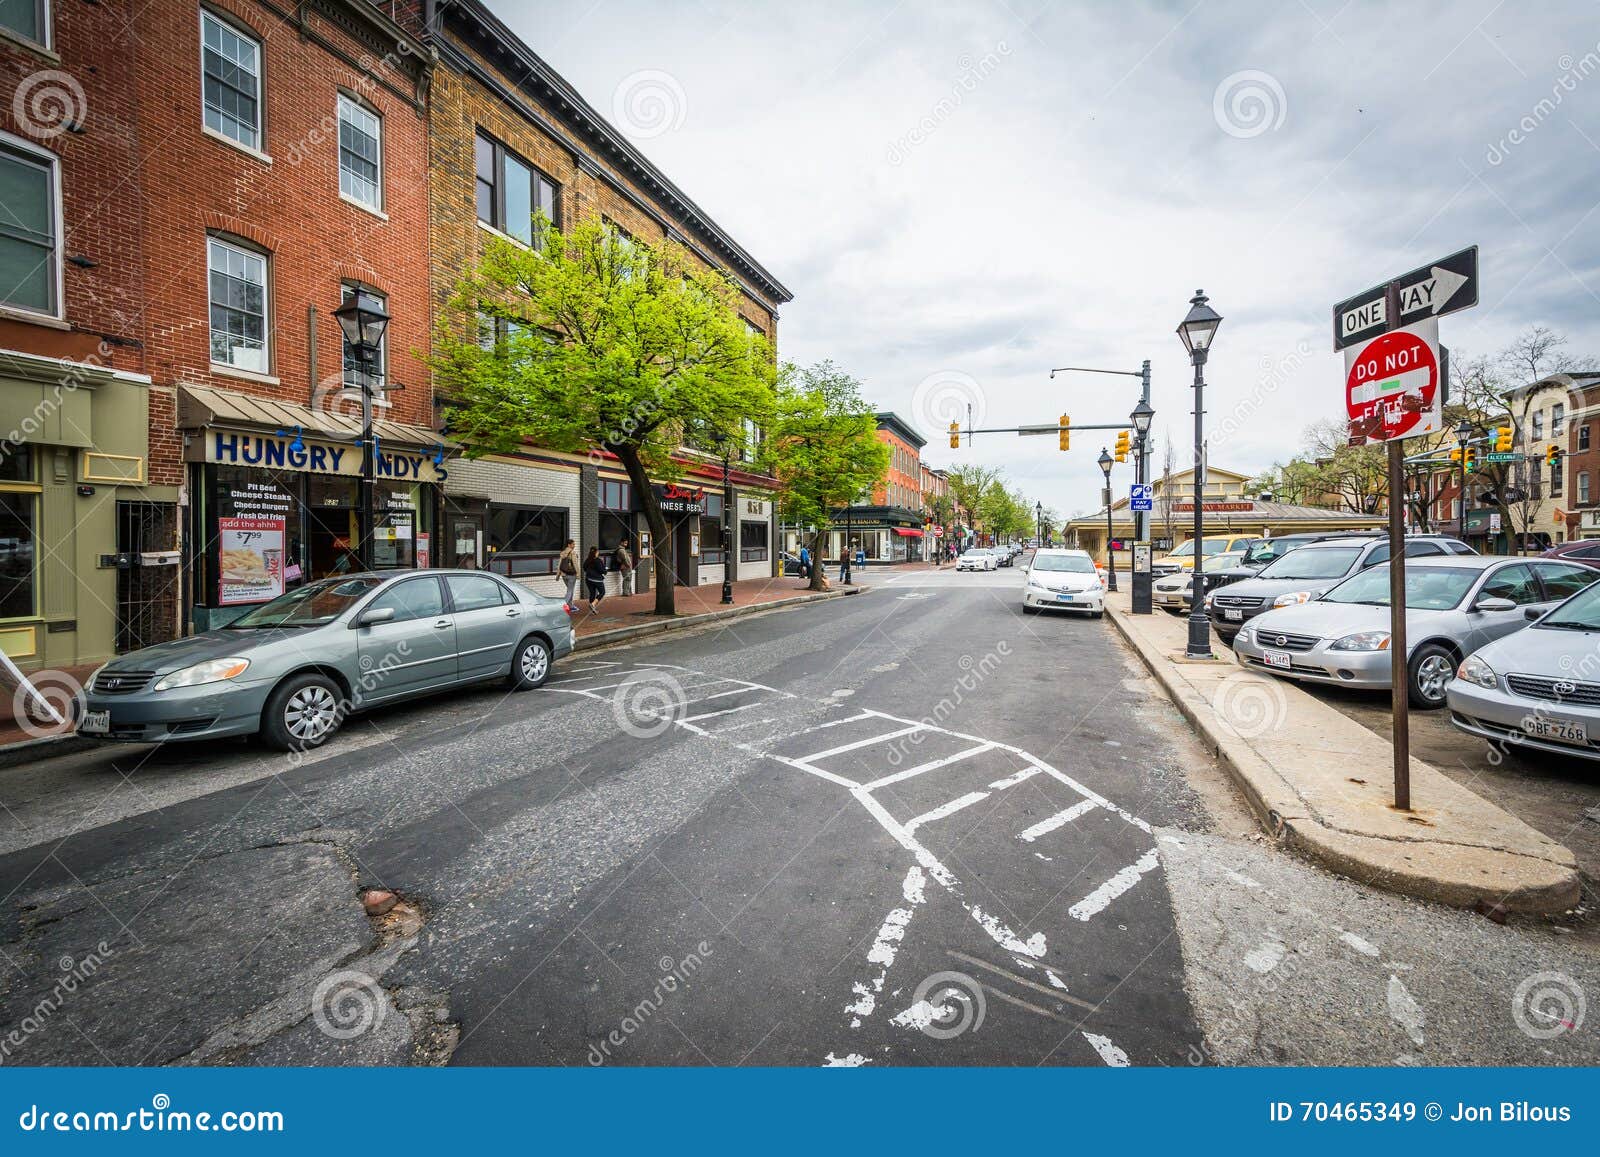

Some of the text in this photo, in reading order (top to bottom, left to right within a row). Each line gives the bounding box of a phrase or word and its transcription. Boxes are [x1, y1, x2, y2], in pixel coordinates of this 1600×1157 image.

[1346, 302, 1381, 331] ONE
[1357, 345, 1421, 380] DO NOT
[215, 432, 449, 482] HUNGRY NDY'S
[247, 483, 277, 492] Pit Beef
[230, 490, 292, 501] Cheese Steaks
[233, 501, 289, 511] Cheese Burgers
[660, 501, 684, 511] INESE
[1217, 503, 1251, 511] MARKET
[257, 512, 269, 520] Cut
[269, 513, 286, 521] Fries
[222, 520, 239, 528] add
